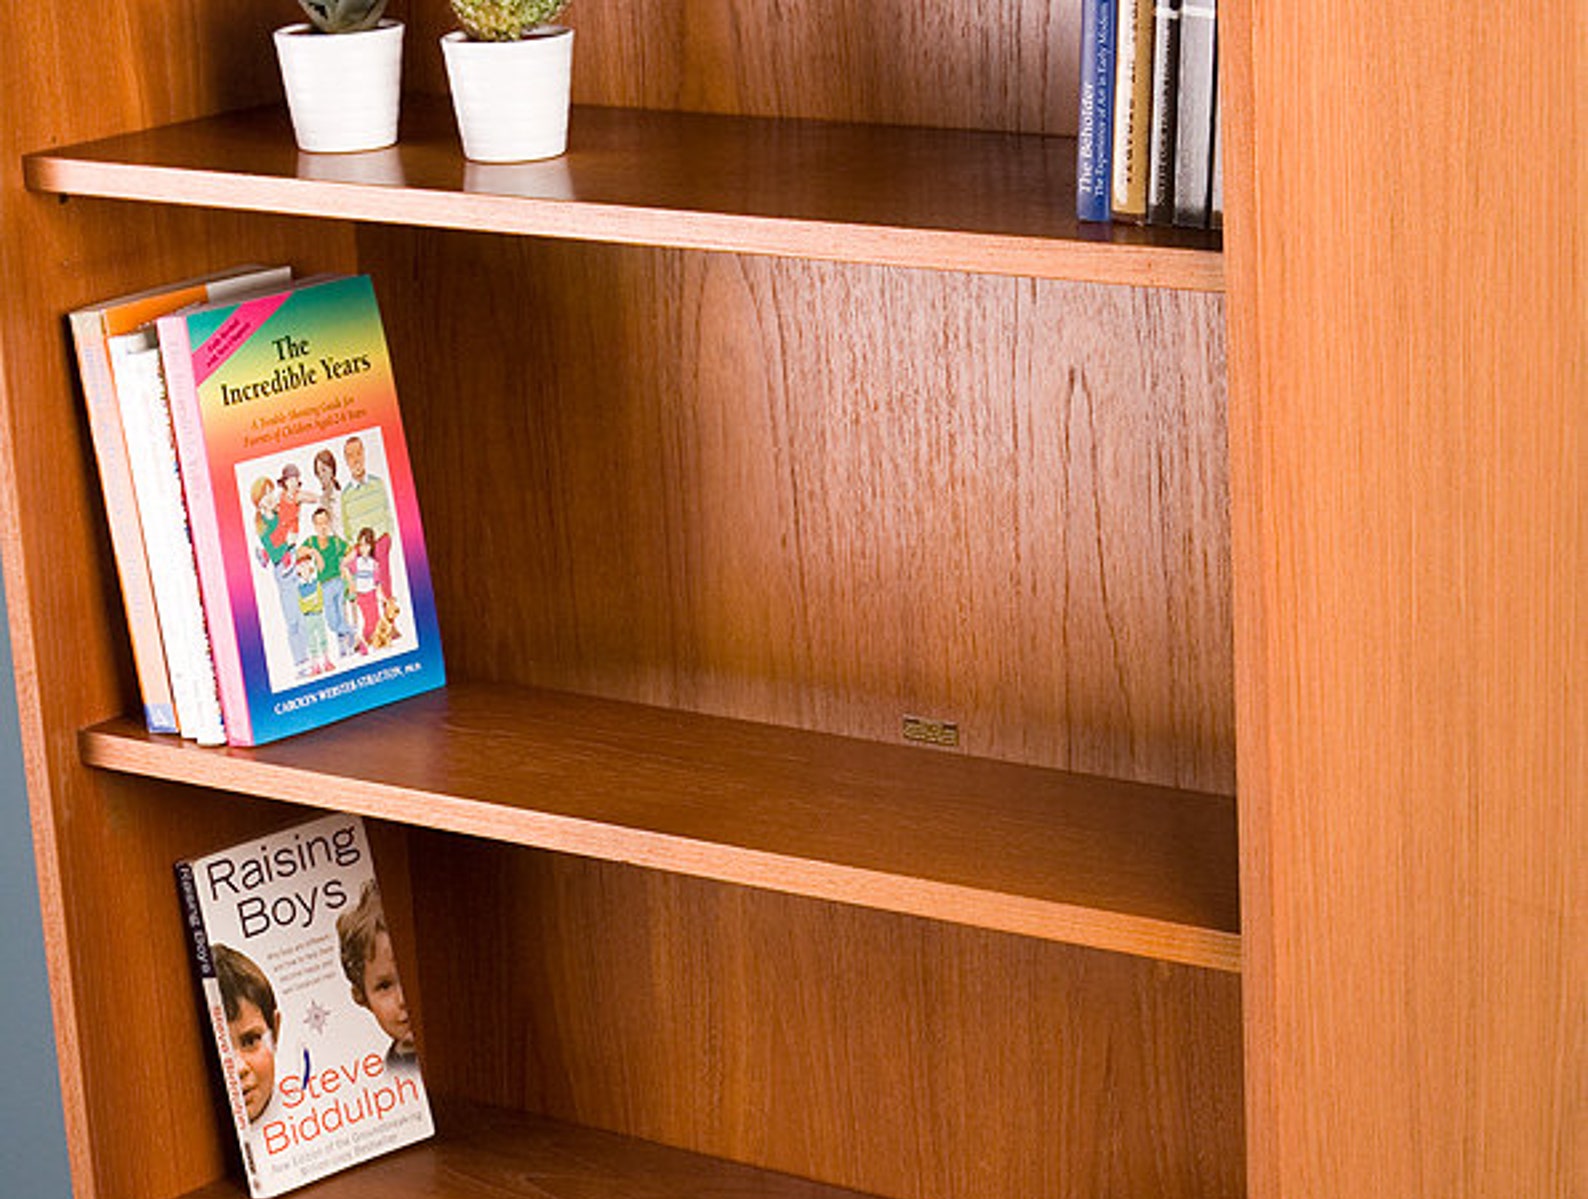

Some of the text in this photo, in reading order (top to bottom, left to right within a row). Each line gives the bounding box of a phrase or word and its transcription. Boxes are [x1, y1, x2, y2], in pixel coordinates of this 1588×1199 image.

[1079, 82, 1094, 193] The Beholder
[272, 335, 310, 361] The
[220, 353, 371, 406] Incredible Years
[207, 824, 362, 901] Raising
[237, 878, 348, 939] Boys
[279, 1052, 384, 1108] Steve
[263, 1076, 420, 1157] Biddulph
